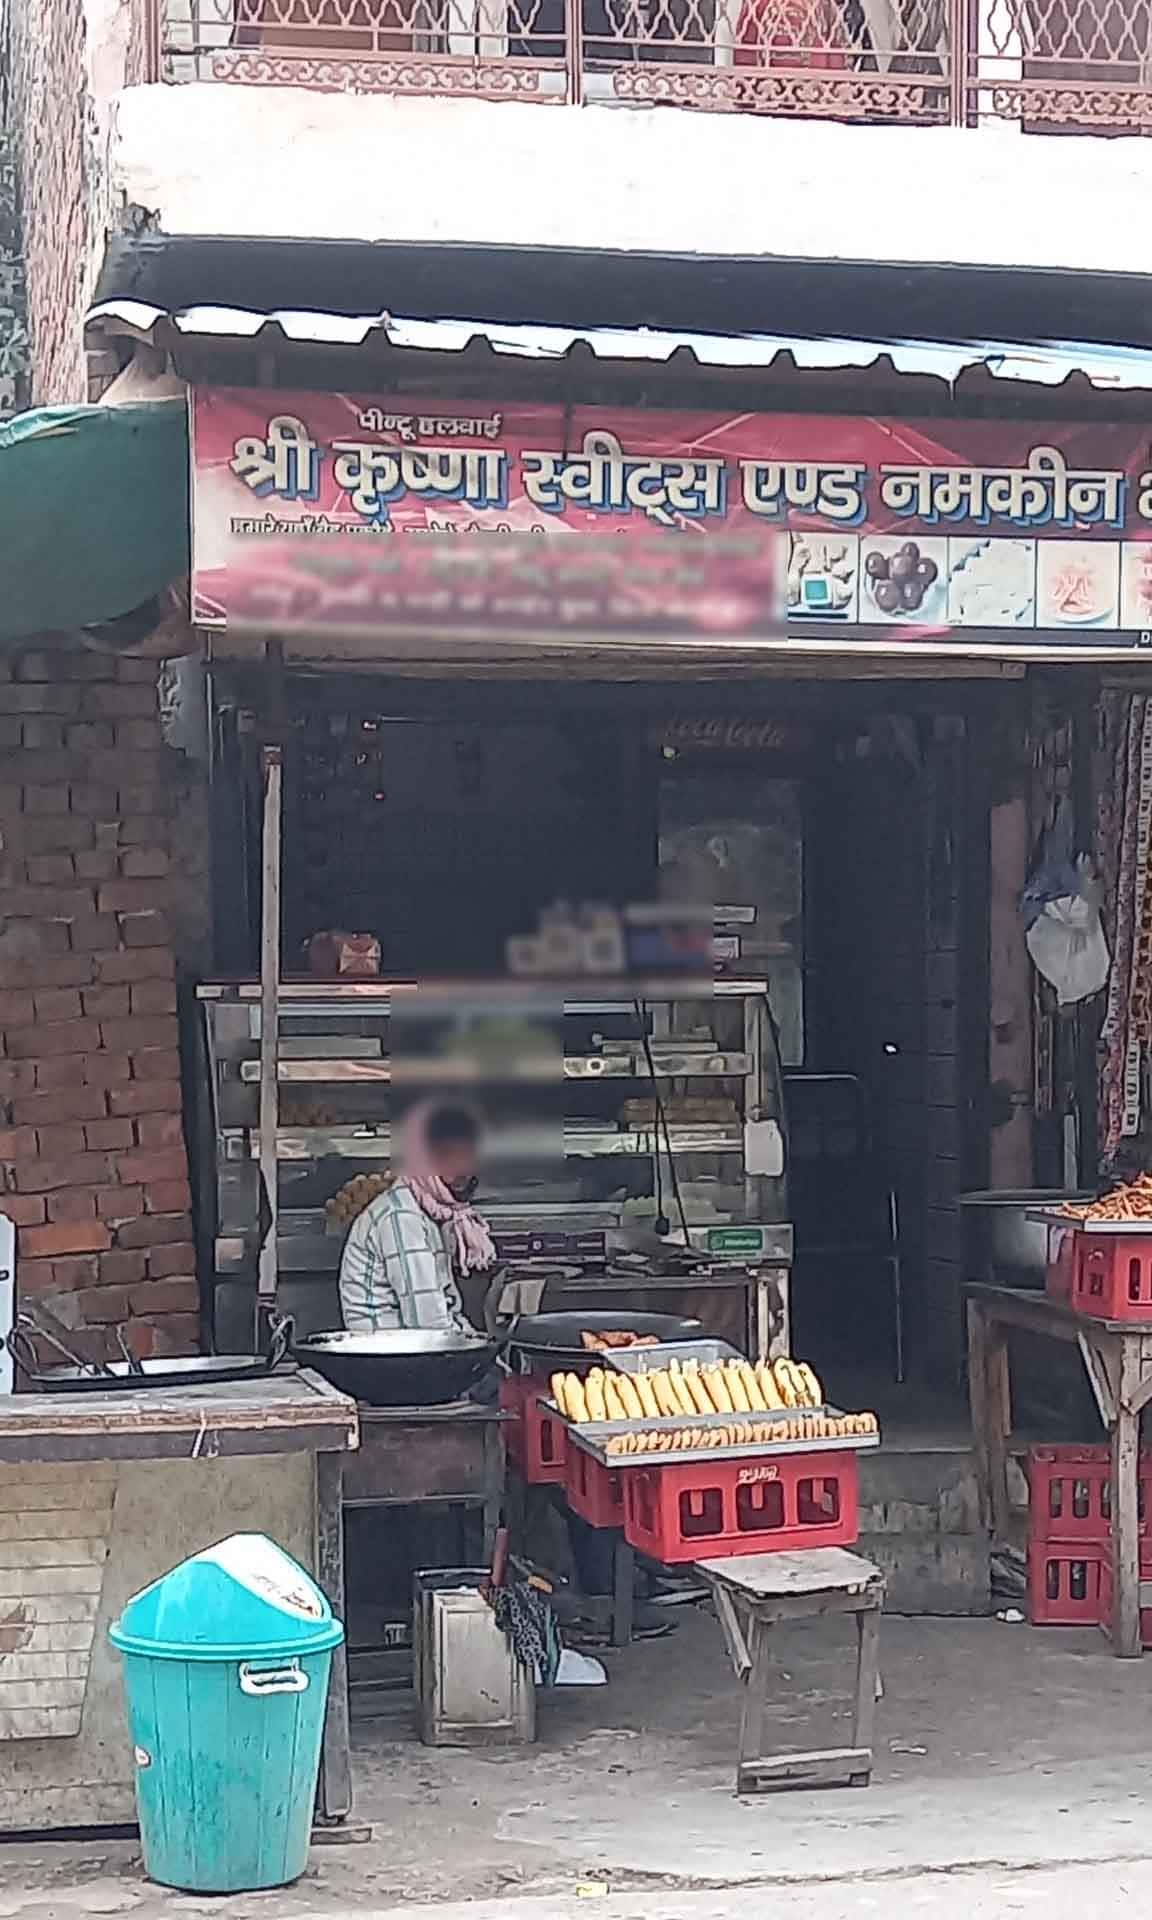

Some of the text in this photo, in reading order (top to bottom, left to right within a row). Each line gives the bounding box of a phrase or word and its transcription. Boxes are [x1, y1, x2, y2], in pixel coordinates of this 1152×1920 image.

[229, 414, 320, 500] श्री
[331, 440, 508, 516] कृष्णा
[520, 429, 727, 525] स्वीट्स
[738, 459, 867, 524] एण्ड
[879, 445, 1126, 528] नमकीन
